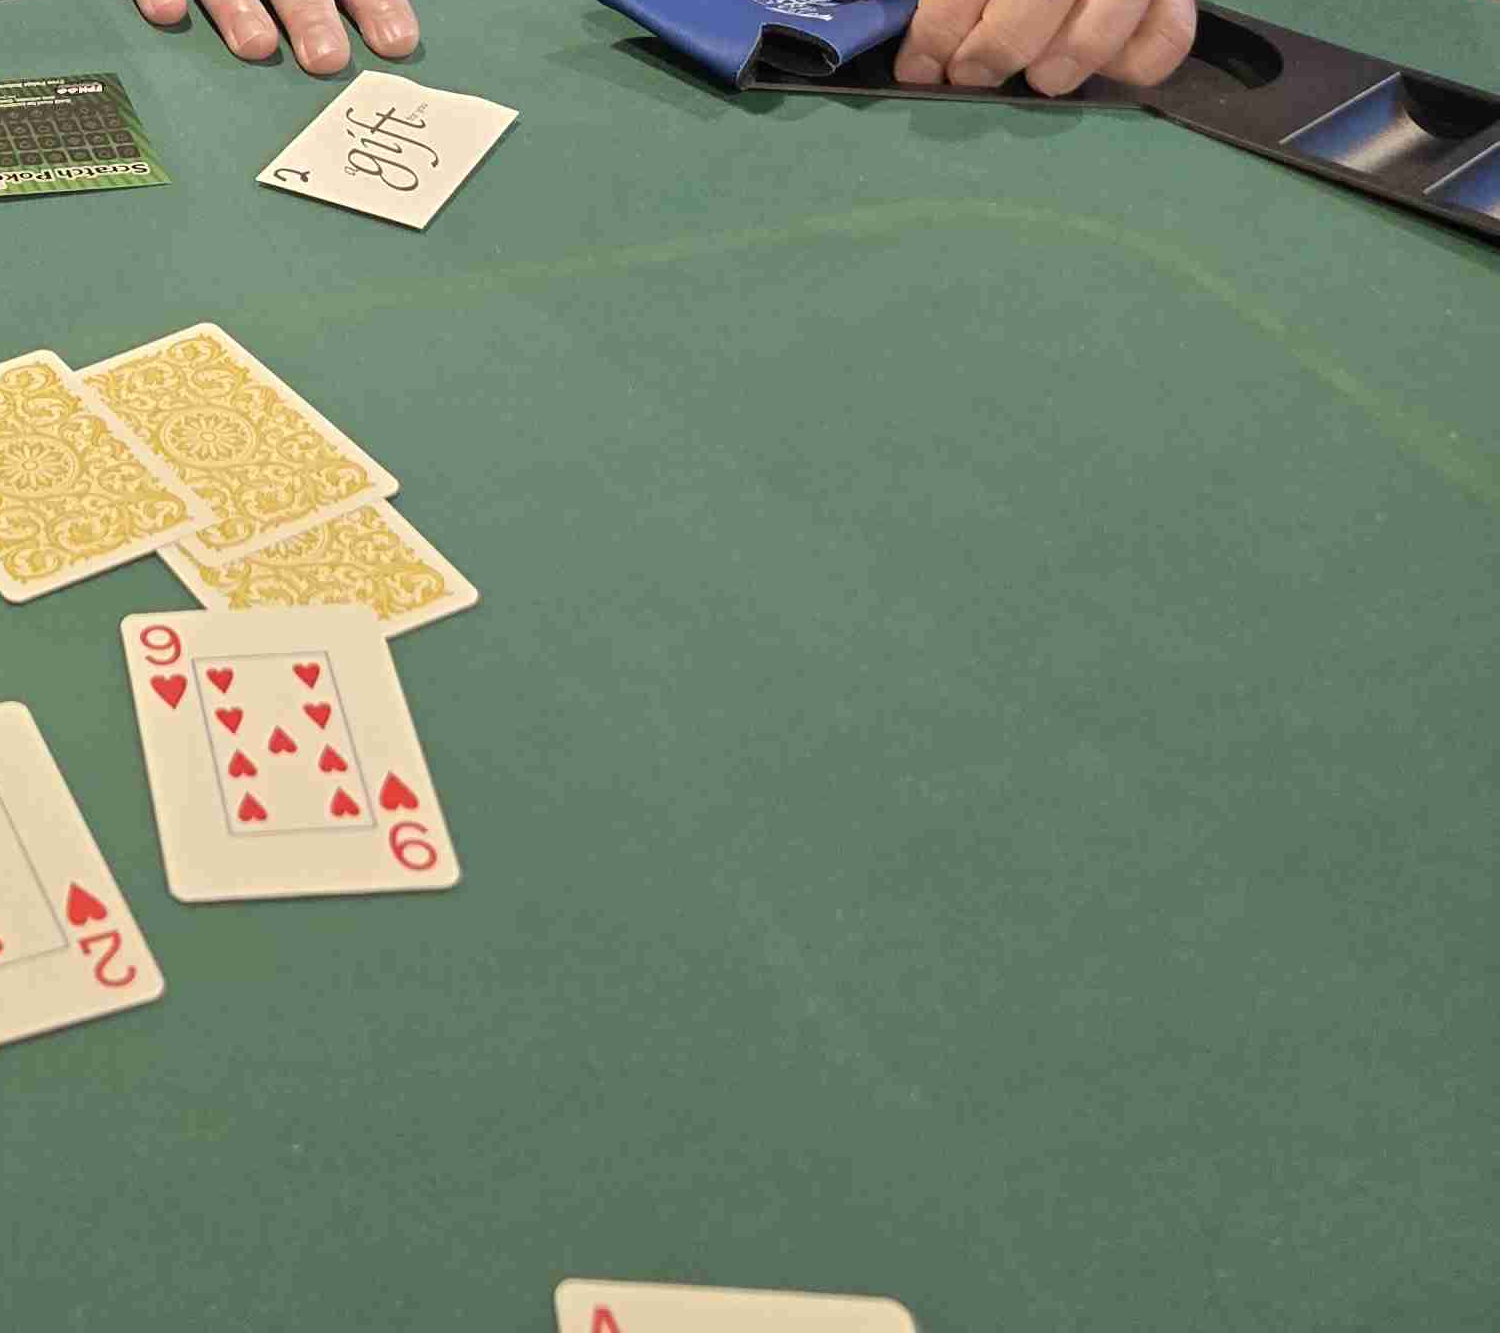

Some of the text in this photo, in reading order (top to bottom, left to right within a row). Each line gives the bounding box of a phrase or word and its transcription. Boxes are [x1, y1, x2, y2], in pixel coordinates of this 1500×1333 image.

[55, 162, 150, 182] Scratch
[346, 107, 439, 192] gift
[139, 624, 182, 666] 9
[388, 821, 438, 872] 9
[77, 930, 137, 989] 2
